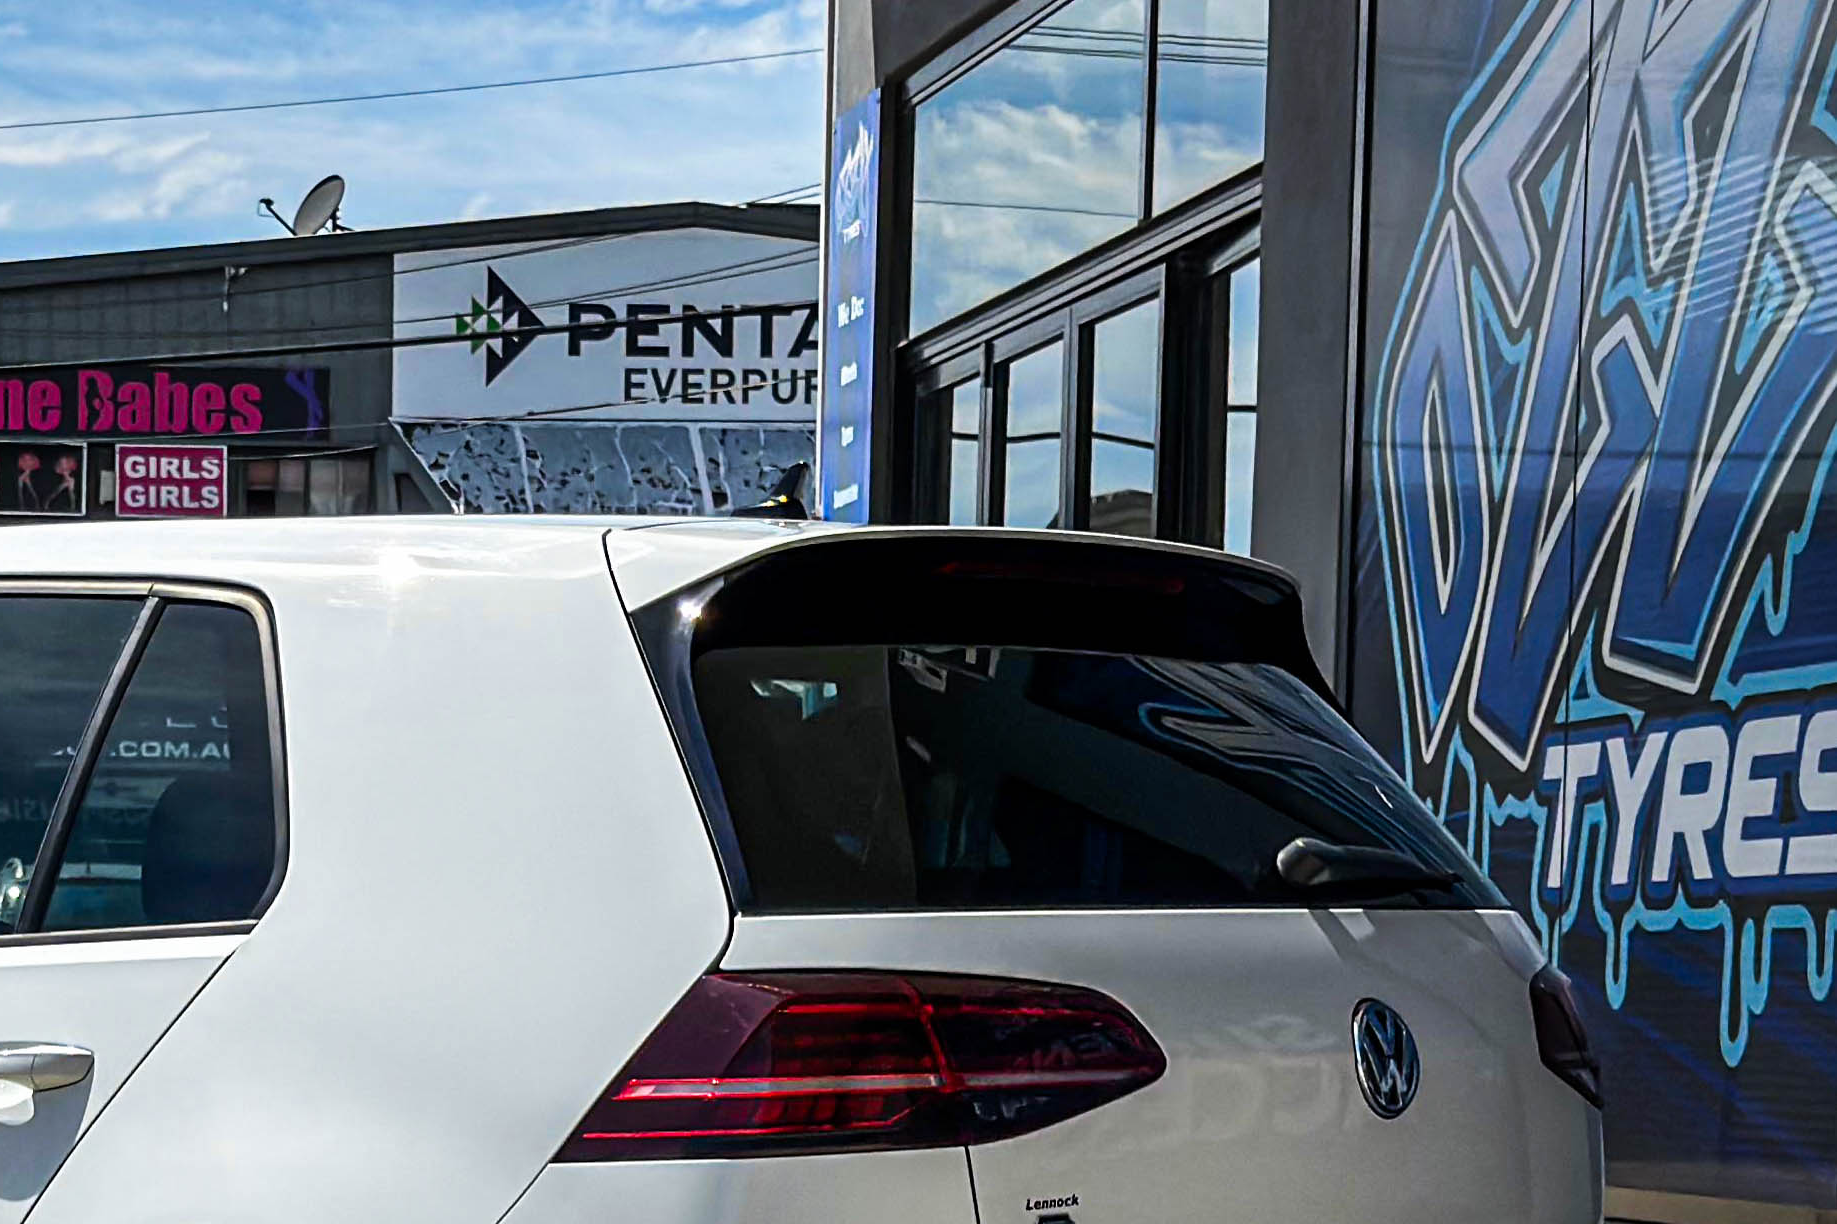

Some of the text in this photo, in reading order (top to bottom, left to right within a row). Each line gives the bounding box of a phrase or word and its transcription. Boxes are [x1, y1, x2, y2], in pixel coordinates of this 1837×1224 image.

[78, 370, 262, 434] Babes
[123, 455, 220, 480] GIRLS
[123, 485, 220, 509] GIRLS
[1542, 708, 1837, 889] TYRES
[1025, 1193, 1080, 1211] Lennock
